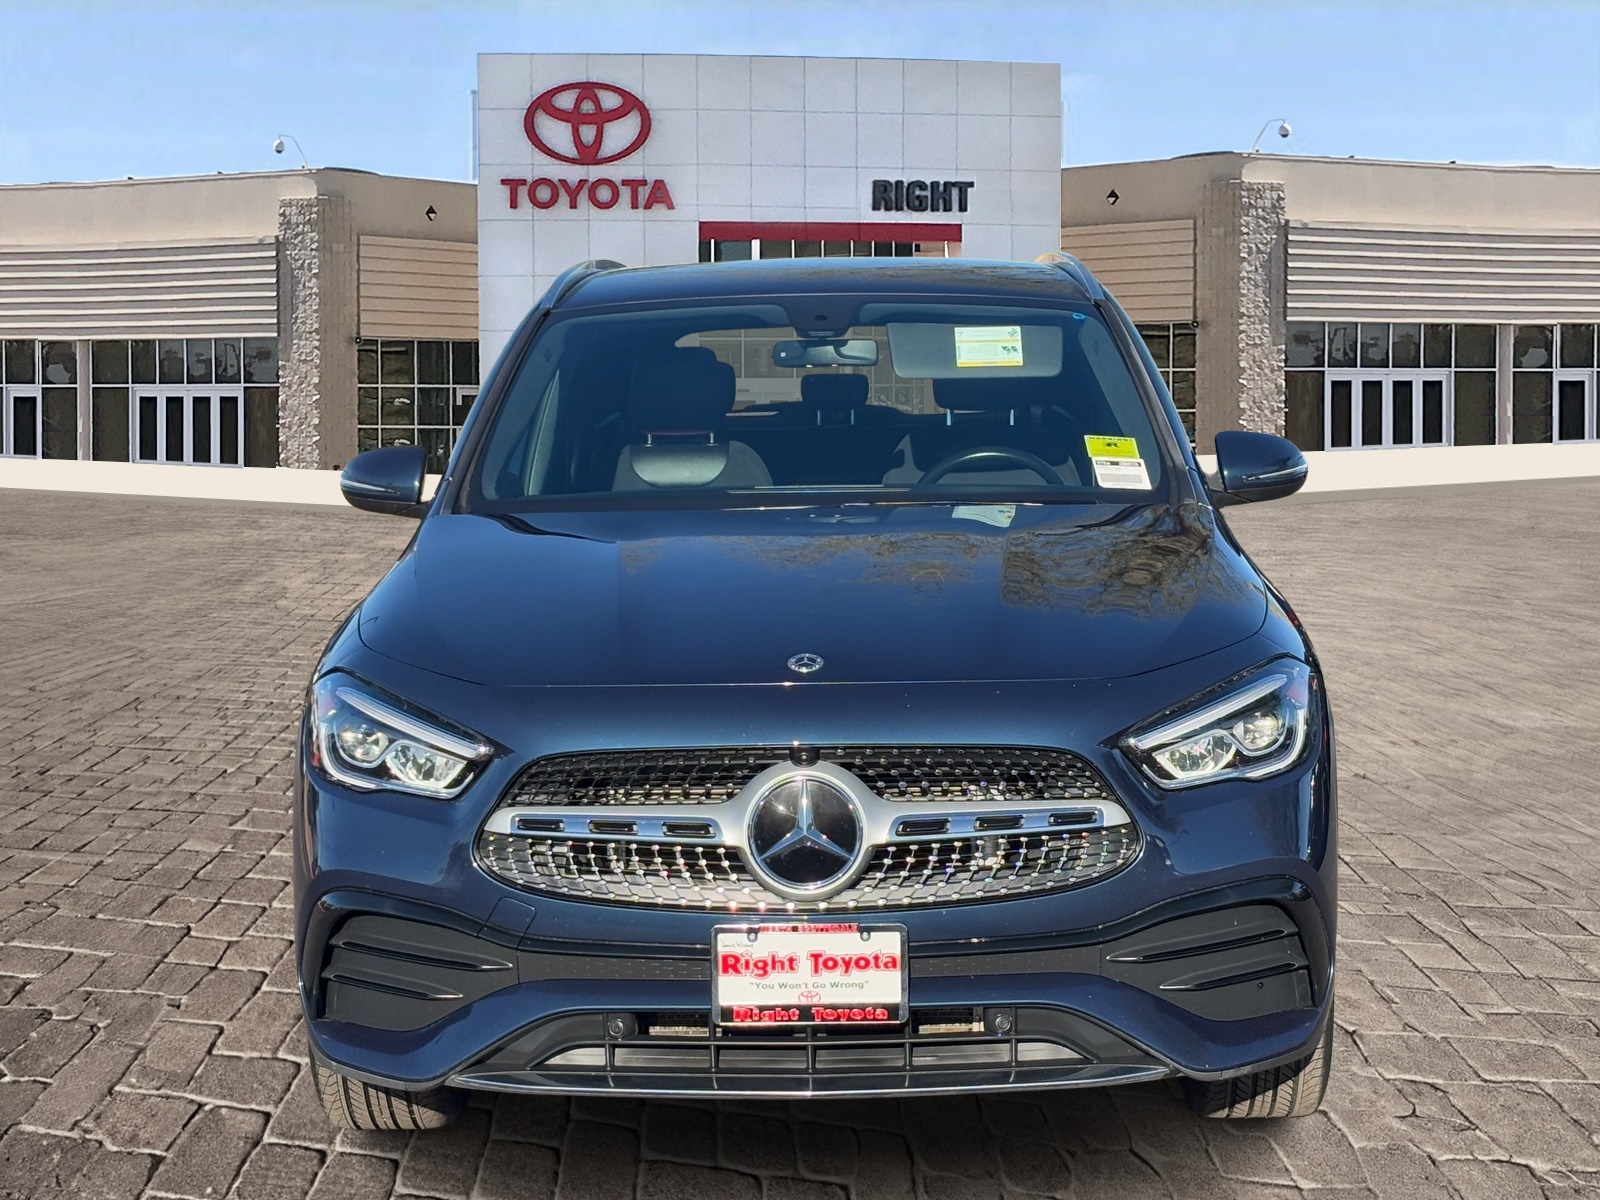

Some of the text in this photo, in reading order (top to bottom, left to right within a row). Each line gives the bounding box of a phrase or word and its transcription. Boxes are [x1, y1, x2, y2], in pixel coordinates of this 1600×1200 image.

[500, 178, 676, 211] TOYOTA
[871, 179, 976, 213] RIGHT
[719, 950, 900, 979] Right Toyota
[778, 981, 809, 990] Won't
[812, 981, 827, 990] Go
[732, 1006, 889, 1022] Right Toyota
